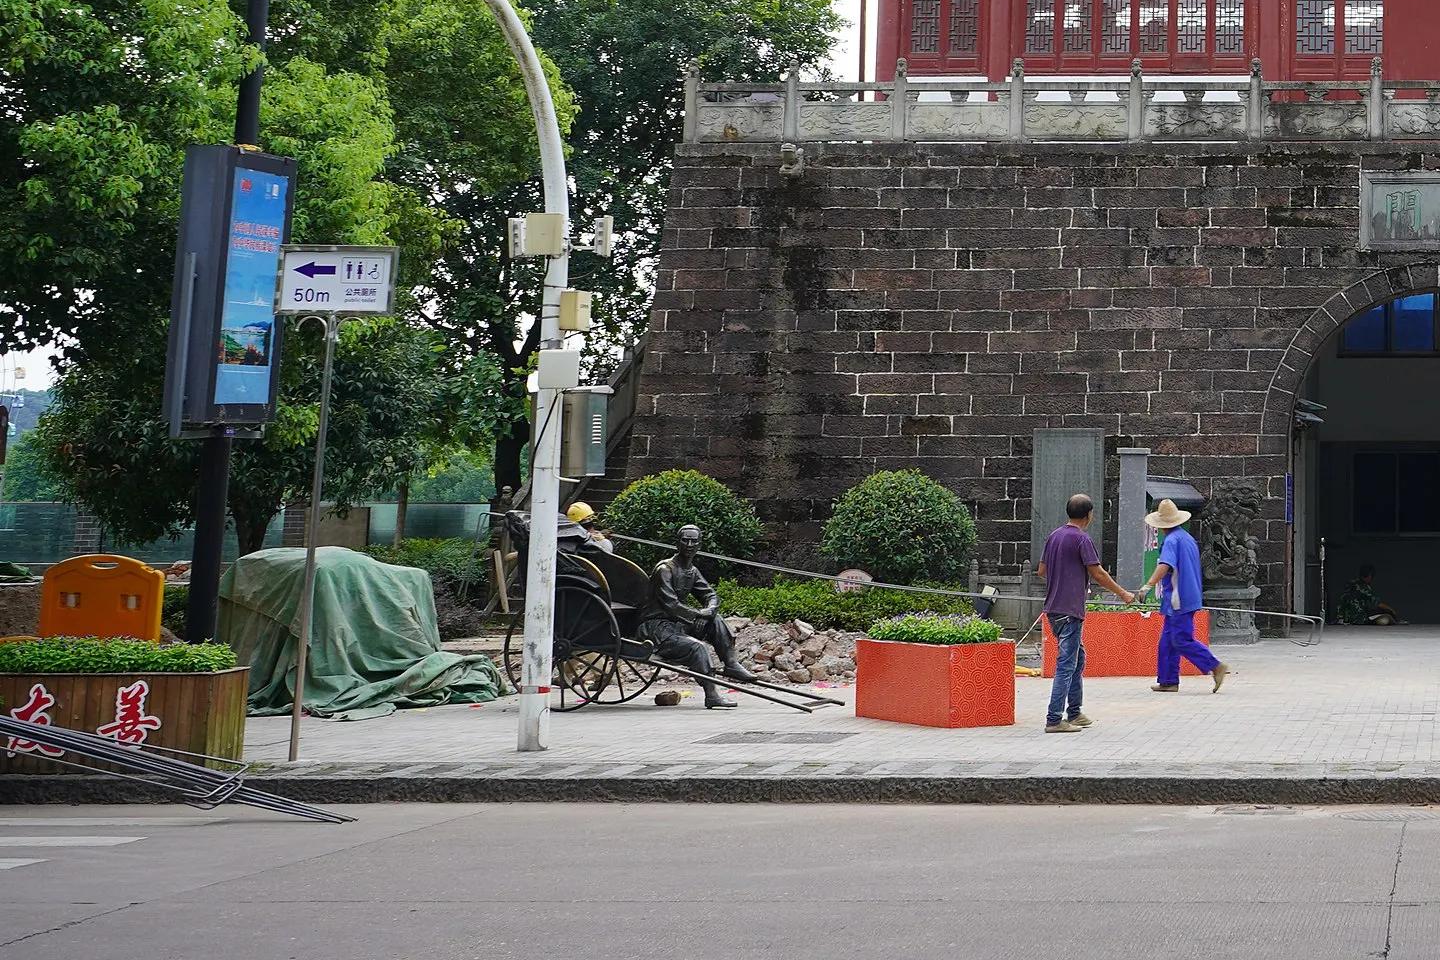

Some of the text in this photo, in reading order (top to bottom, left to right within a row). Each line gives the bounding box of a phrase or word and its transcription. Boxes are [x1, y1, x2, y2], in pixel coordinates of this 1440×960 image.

[293, 288, 330, 302] 50m
[345, 288, 377, 297] 公共厕所
[7, 680, 161, 758] 友善
